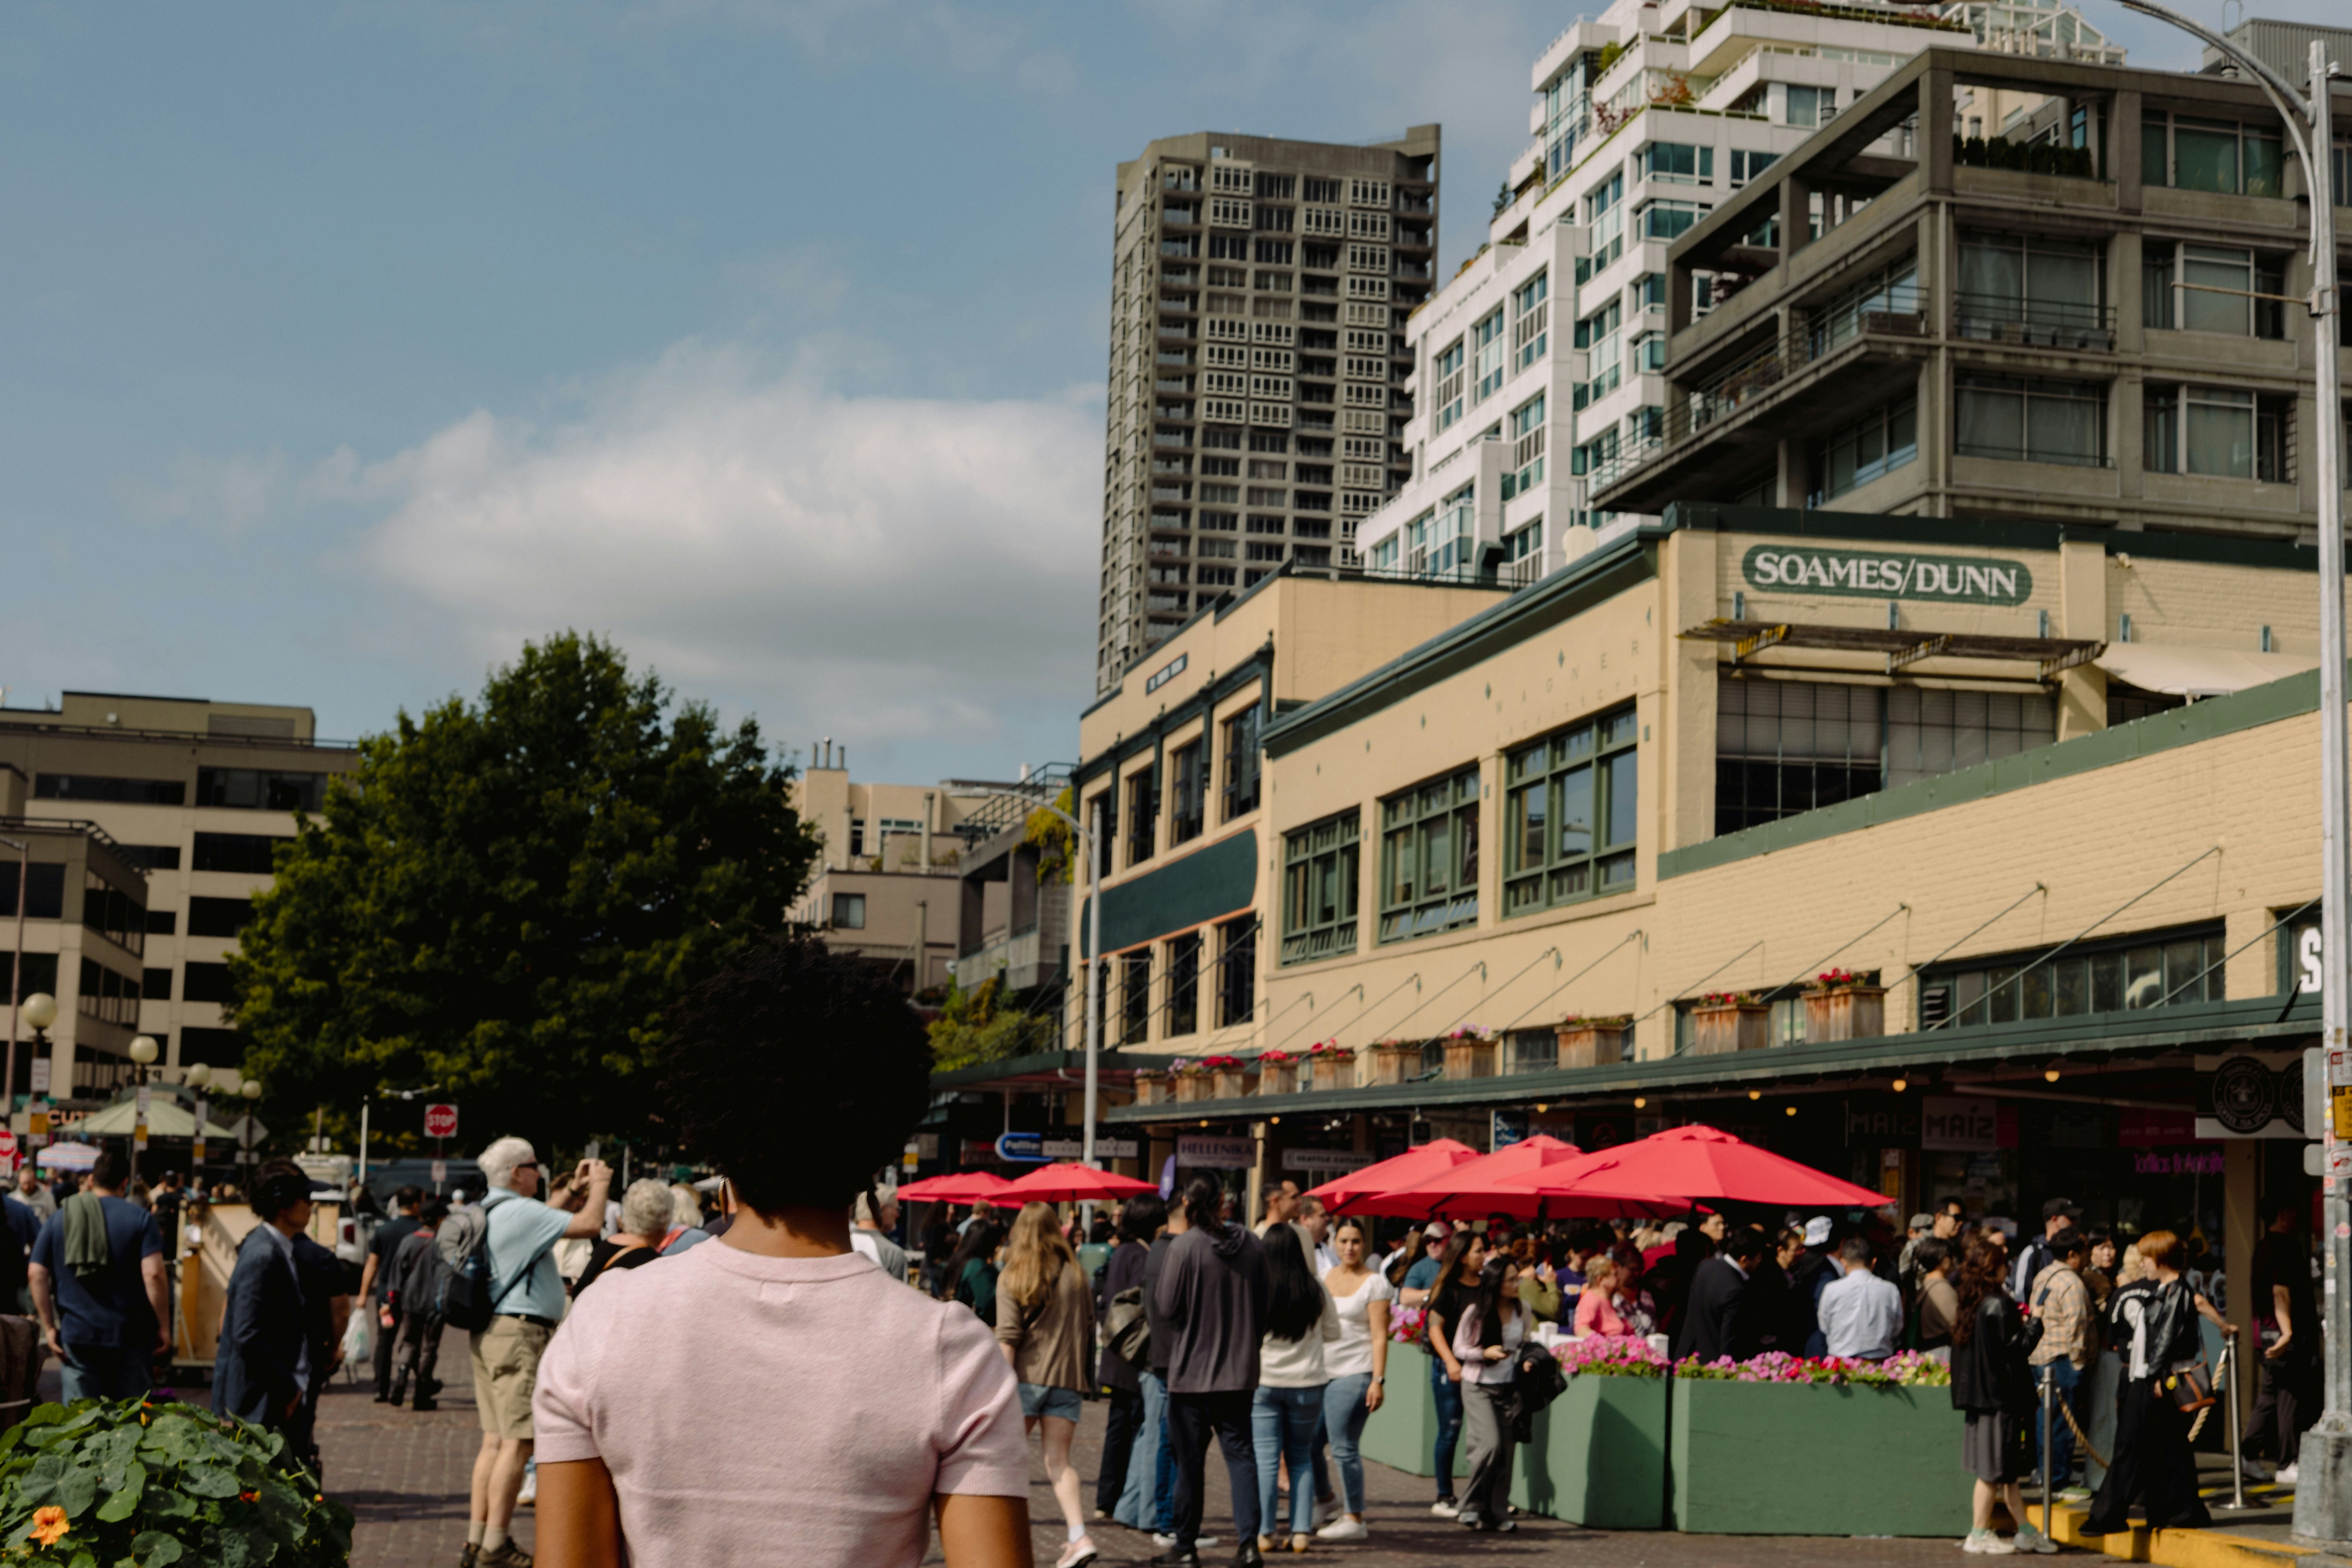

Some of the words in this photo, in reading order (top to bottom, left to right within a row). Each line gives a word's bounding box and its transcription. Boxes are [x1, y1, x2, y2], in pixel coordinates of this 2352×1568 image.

[1755, 552, 2017, 597] SOAMES/DUNN
[2300, 927, 2322, 994] S
[426, 1114, 455, 1127] STOP
[1182, 1142, 1253, 1155] HELLENIKA
